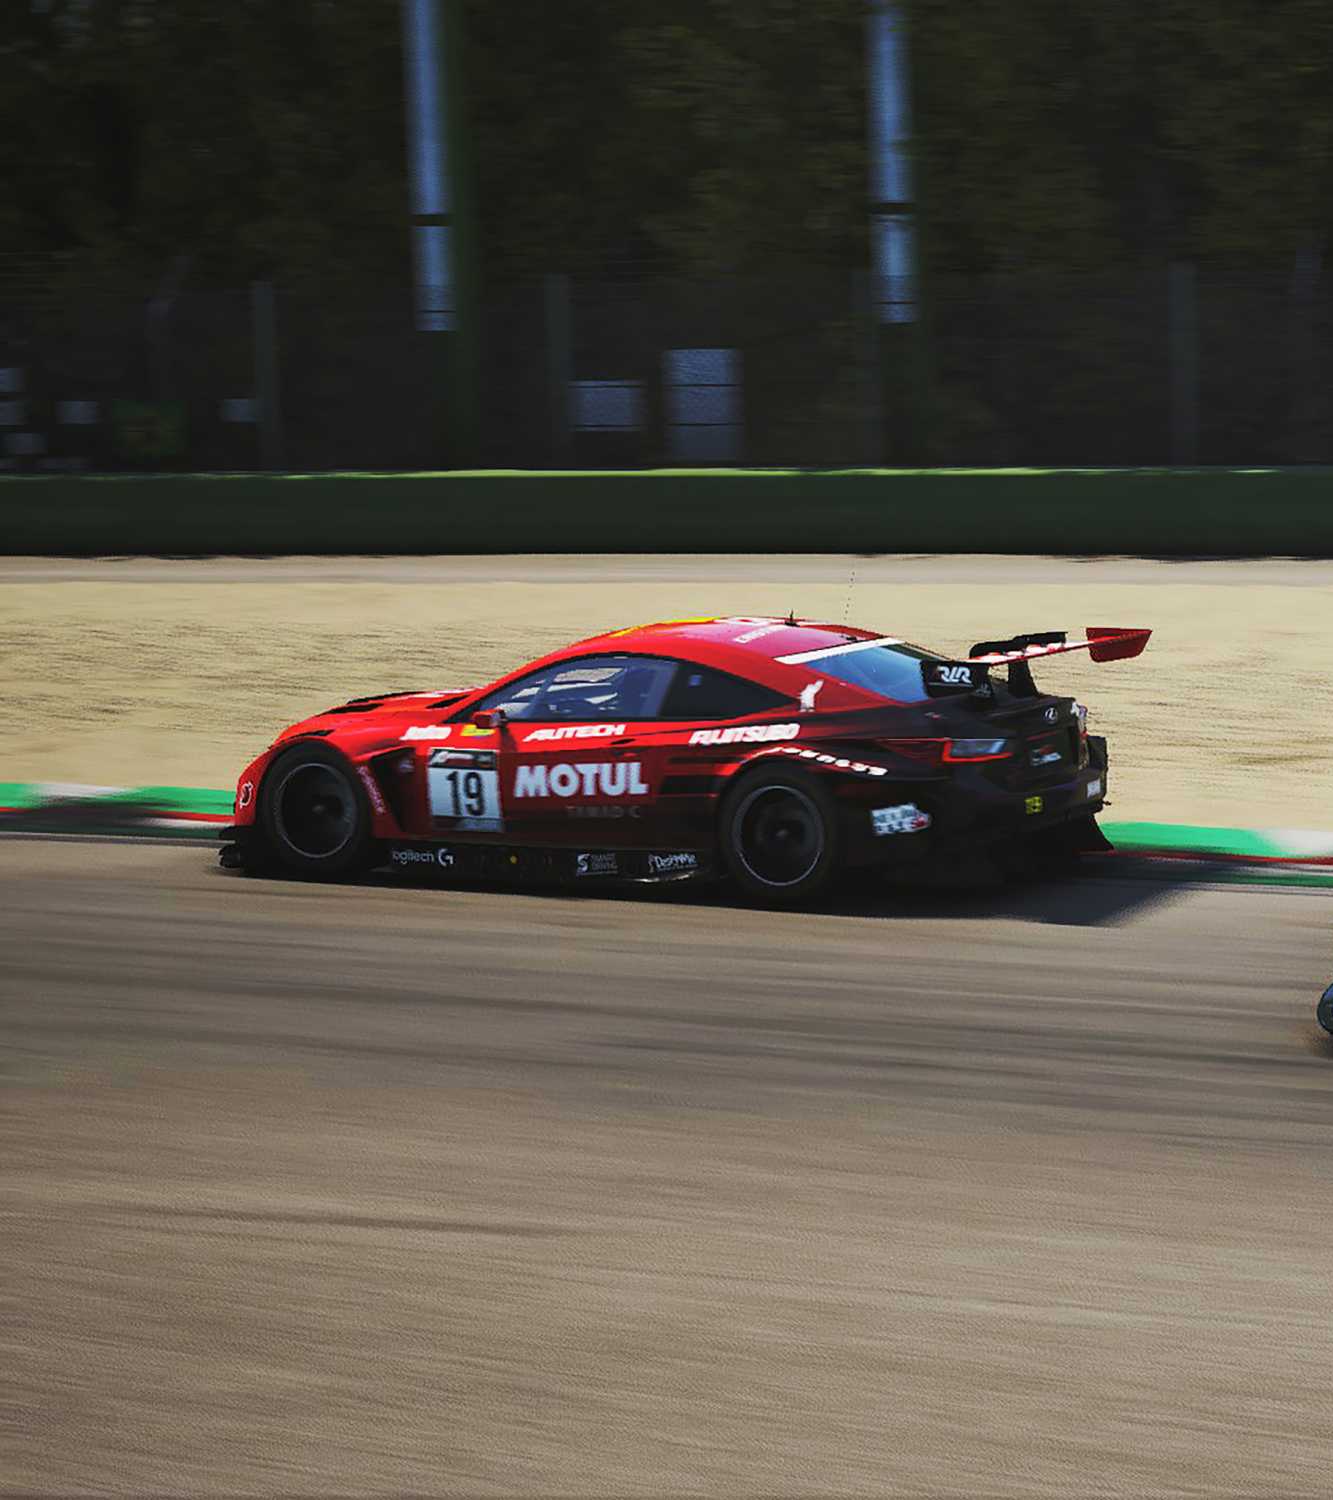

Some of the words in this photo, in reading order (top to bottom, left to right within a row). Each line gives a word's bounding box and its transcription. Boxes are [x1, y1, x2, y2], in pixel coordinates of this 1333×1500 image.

[522, 724, 626, 742] AUTECH
[446, 770, 485, 816] 19
[514, 763, 649, 797] MOTUL
